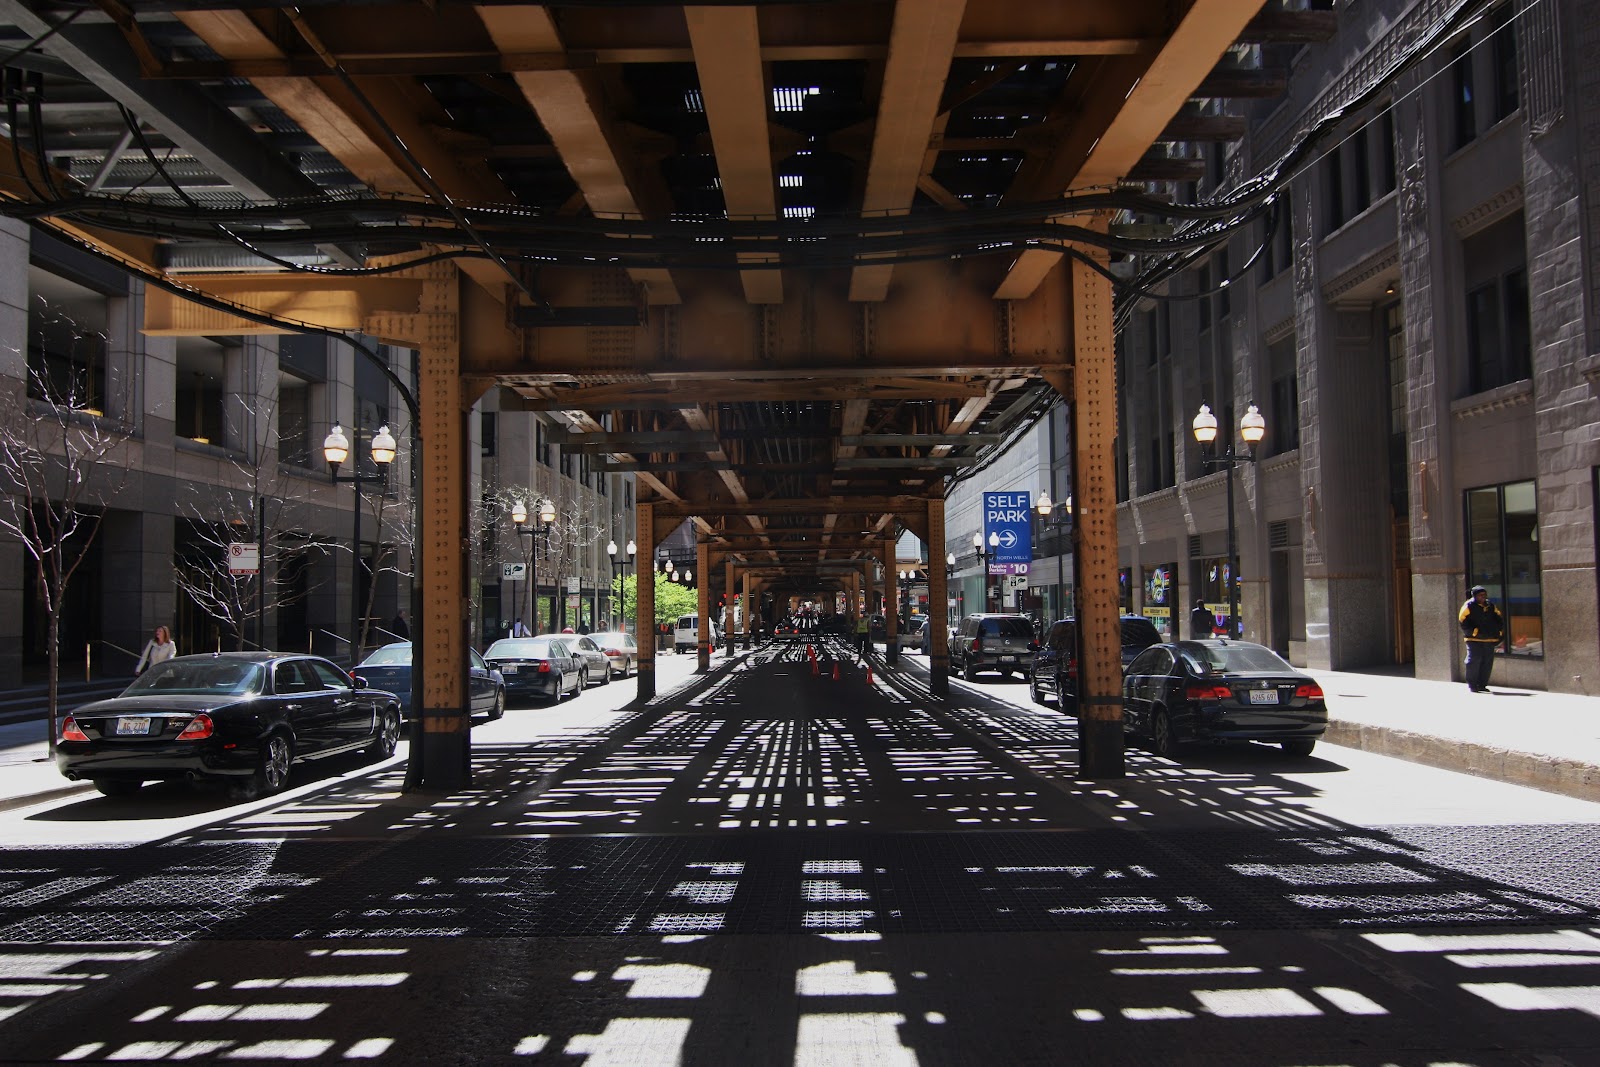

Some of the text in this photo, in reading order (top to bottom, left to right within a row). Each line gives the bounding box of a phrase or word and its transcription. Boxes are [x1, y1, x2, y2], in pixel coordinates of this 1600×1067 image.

[987, 495, 1027, 508] SELF
[988, 510, 1028, 523] PARK
[1010, 563, 1028, 574] $10
